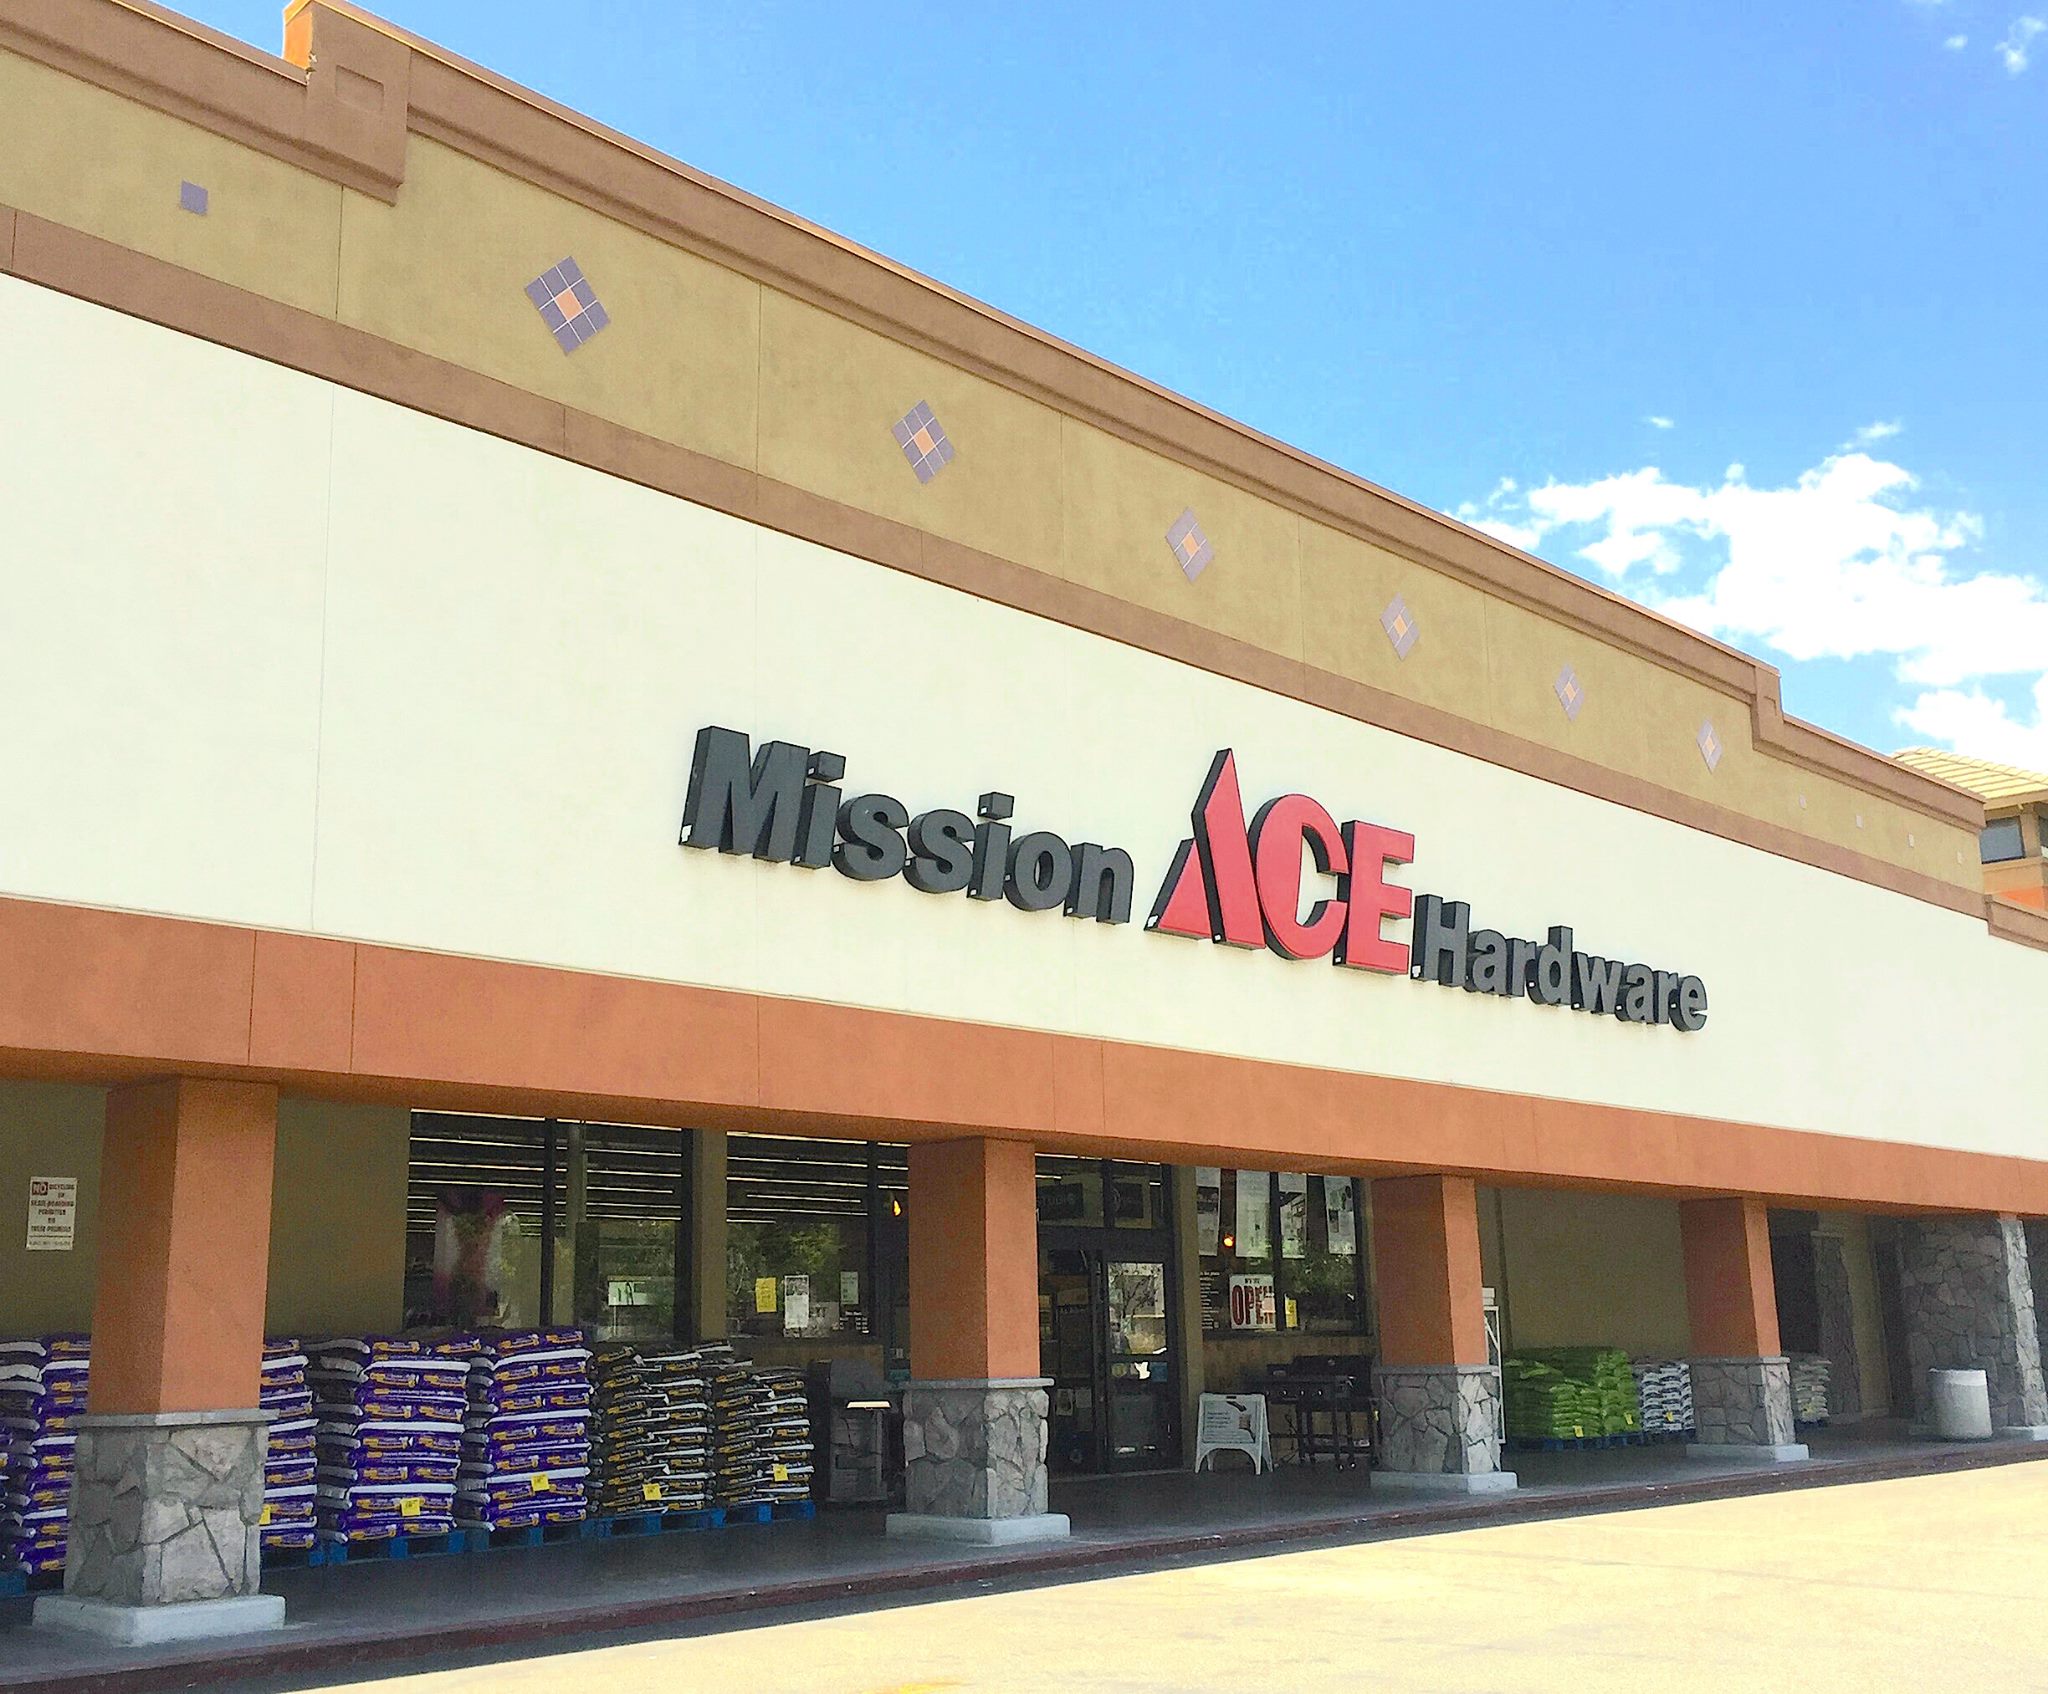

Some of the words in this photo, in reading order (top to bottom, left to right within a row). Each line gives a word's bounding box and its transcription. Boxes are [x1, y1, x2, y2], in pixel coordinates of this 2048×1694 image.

[678, 726, 1134, 924] Mission
[1144, 748, 1415, 976] ACE
[1411, 894, 1708, 1032] Hardware
[33, 1183, 47, 1194] NO
[1232, 1285, 1274, 1325] OPEN
